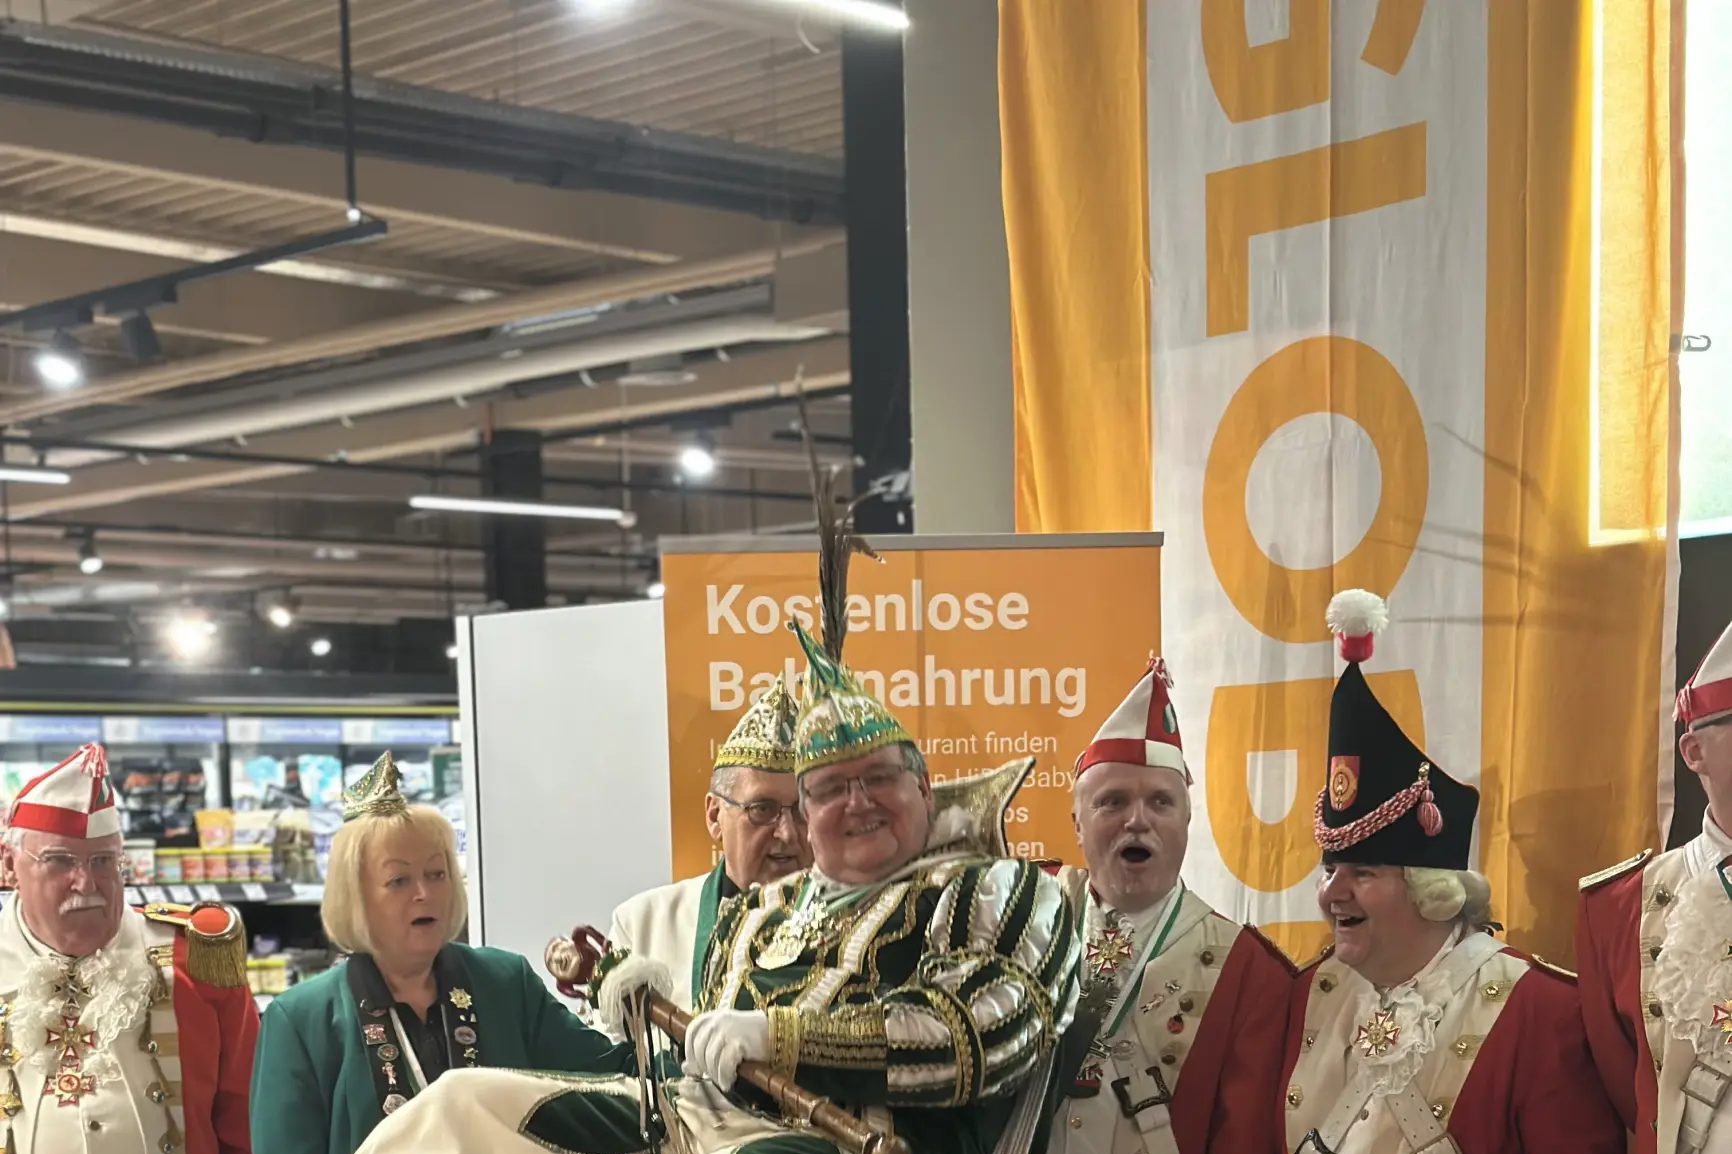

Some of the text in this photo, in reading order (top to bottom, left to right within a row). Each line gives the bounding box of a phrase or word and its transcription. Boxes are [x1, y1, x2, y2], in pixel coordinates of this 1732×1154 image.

[706, 579, 1029, 635] Kosenlose
[709, 655, 1087, 718] Babnahrung
[985, 730, 1057, 753] finden
